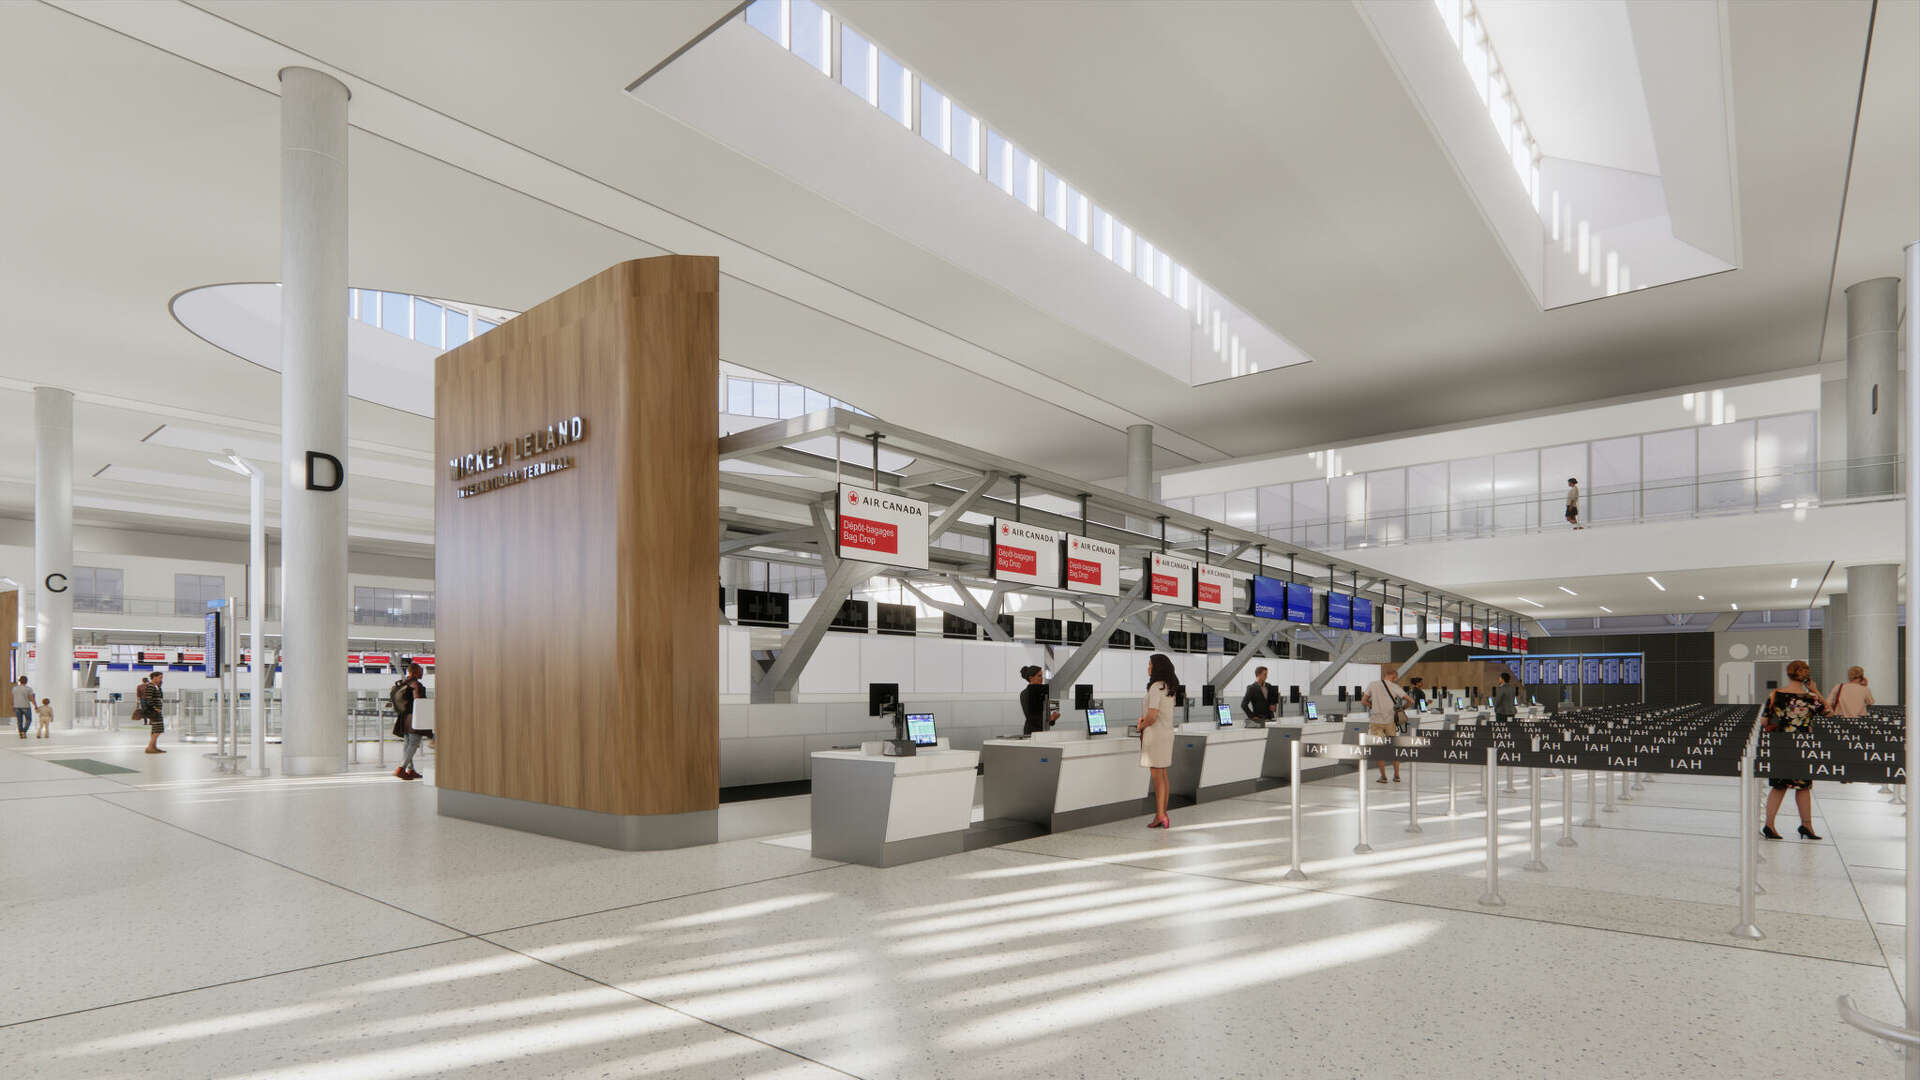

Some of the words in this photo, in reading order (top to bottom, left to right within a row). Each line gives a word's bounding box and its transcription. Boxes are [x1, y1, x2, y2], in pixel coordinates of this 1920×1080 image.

[513, 416, 583, 460] LELAND
[305, 450, 345, 492] D
[523, 456, 570, 480] TERMINAL
[863, 496, 881, 508] AIR
[882, 500, 922, 517] CANADA
[843, 531, 859, 545] Bag
[860, 533, 877, 546] Drop
[1011, 528, 1025, 538] AIR
[1025, 531, 1055, 544] CANADA
[1080, 543, 1091, 552] AIR
[1091, 545, 1116, 556] CANADA
[46, 574, 68, 592] C
[1756, 644, 1788, 657] Men
[1422, 730, 1440, 738] IAH
[1456, 731, 1475, 739] IAH
[1492, 732, 1512, 740] IAH
[1573, 734, 1591, 742] AH
[1708, 731, 1728, 739] IAH
[1792, 733, 1815, 741] IAH
[1372, 735, 1392, 745] IAH
[1411, 736, 1432, 746] IAH
[1451, 738, 1472, 748] IAH
[1493, 740, 1516, 749] IAH
[1610, 735, 1632, 744] IAH
[1653, 736, 1676, 745] IAH
[1699, 738, 1722, 746] IAH
[1795, 740, 1821, 749] IAH
[1306, 744, 1329, 754] IAH
[1350, 745, 1372, 756] IAH
[1542, 742, 1562, 751] AH
[1584, 743, 1610, 753] IAH
[1634, 744, 1661, 754] IAH
[1686, 746, 1714, 756] IAH
[1848, 742, 1876, 751] IAH
[1395, 747, 1419, 758] IAH
[1443, 749, 1469, 760] IAH
[1500, 752, 1521, 762] AH
[1801, 750, 1832, 760] IAH
[1864, 751, 1896, 762] IAH
[1549, 754, 1578, 765] IAH
[1607, 755, 1639, 768] IAH
[1669, 758, 1703, 770] IAH
[1808, 764, 1846, 777] IAH
[1886, 766, 1906, 778] IA
